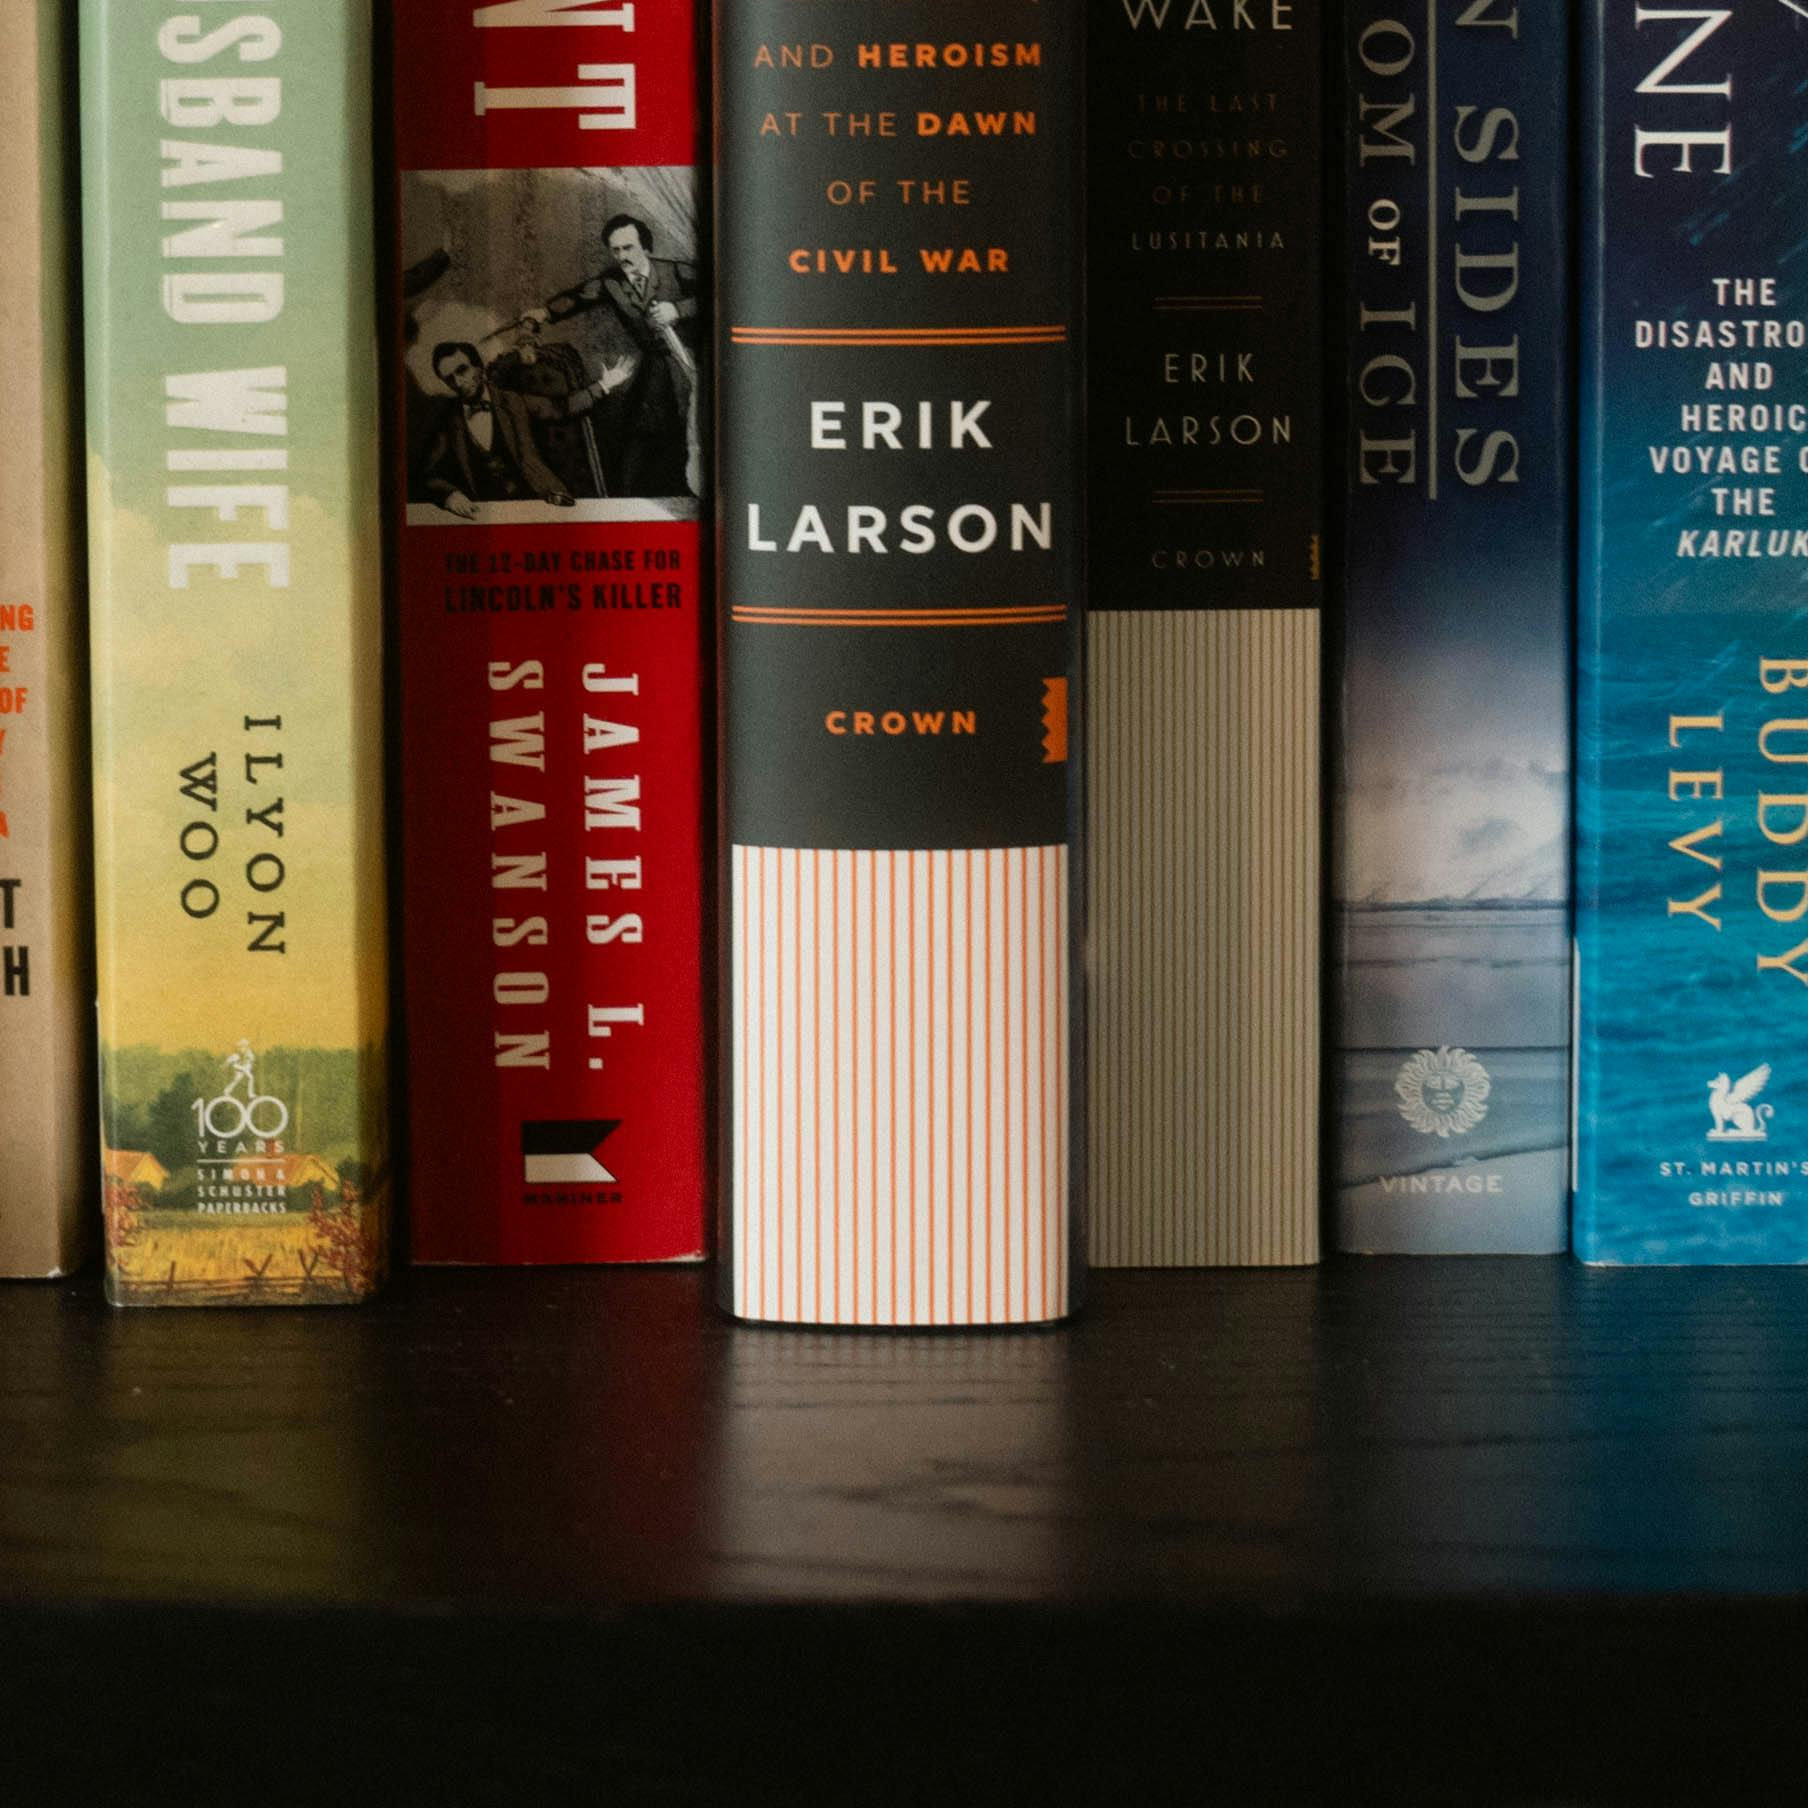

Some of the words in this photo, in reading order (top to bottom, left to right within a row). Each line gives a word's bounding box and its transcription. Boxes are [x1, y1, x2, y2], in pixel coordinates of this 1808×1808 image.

[753, 43, 834, 69] AND
[857, 42, 1042, 70] HEROISM
[759, 111, 803, 137] AT
[824, 111, 897, 138] THE
[915, 111, 1038, 137] DAWN
[825, 179, 878, 206] OF
[896, 179, 971, 205] THE
[1366, 197, 1402, 267] OF
[788, 248, 899, 274] CIVIL
[919, 248, 1009, 274] WAR
[1453, 105, 1520, 488] SIDES
[1711, 277, 1778, 307] THE
[1163, 352, 1255, 384] ERIK
[1704, 361, 1775, 391] AND
[1358, 299, 1418, 487] ICE
[810, 400, 993, 450] ERIK
[1124, 414, 1291, 446] LARSON
[1680, 403, 1808, 434] HEROIC
[164, 364, 291, 590] WIFE
[1648, 445, 1783, 475] VOYAGE
[1710, 487, 1777, 517] THE
[746, 502, 1052, 554] LARSON
[824, 710, 978, 736] CROWN
[581, 661, 645, 946] JAMES
[1666, 712, 1726, 933] LEVY
[178, 751, 221, 919] WOO
[243, 715, 287, 954] ILYON
[487, 658, 551, 1072] SWANSON
[587, 1001, 646, 1072] L.
